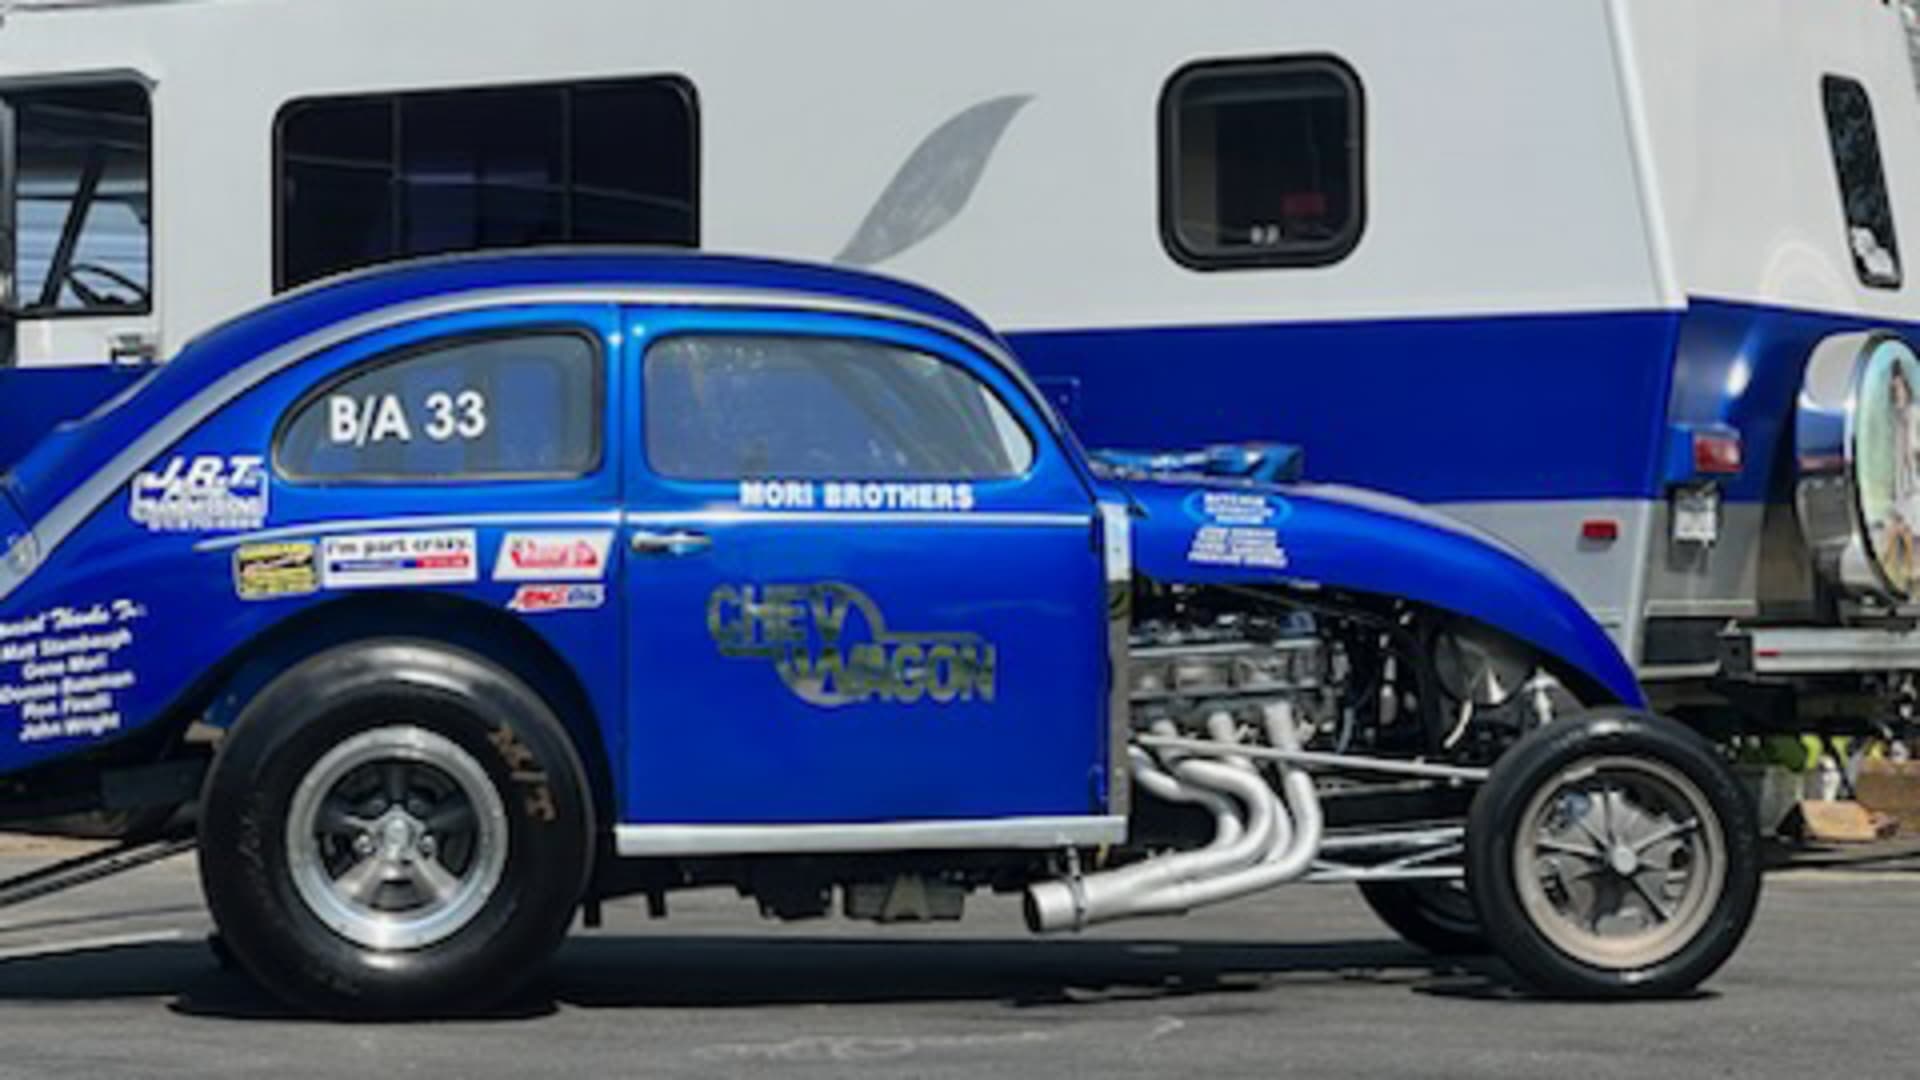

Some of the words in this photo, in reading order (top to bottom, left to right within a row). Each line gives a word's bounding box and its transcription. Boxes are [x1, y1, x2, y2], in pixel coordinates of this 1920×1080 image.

[330, 394, 411, 447] B/A
[425, 389, 486, 440] 33
[740, 481, 814, 508] MORI
[824, 482, 975, 510] BROTHERS
[365, 538, 410, 560] part
[707, 581, 852, 642] CHEV
[776, 640, 996, 703] WAGON
